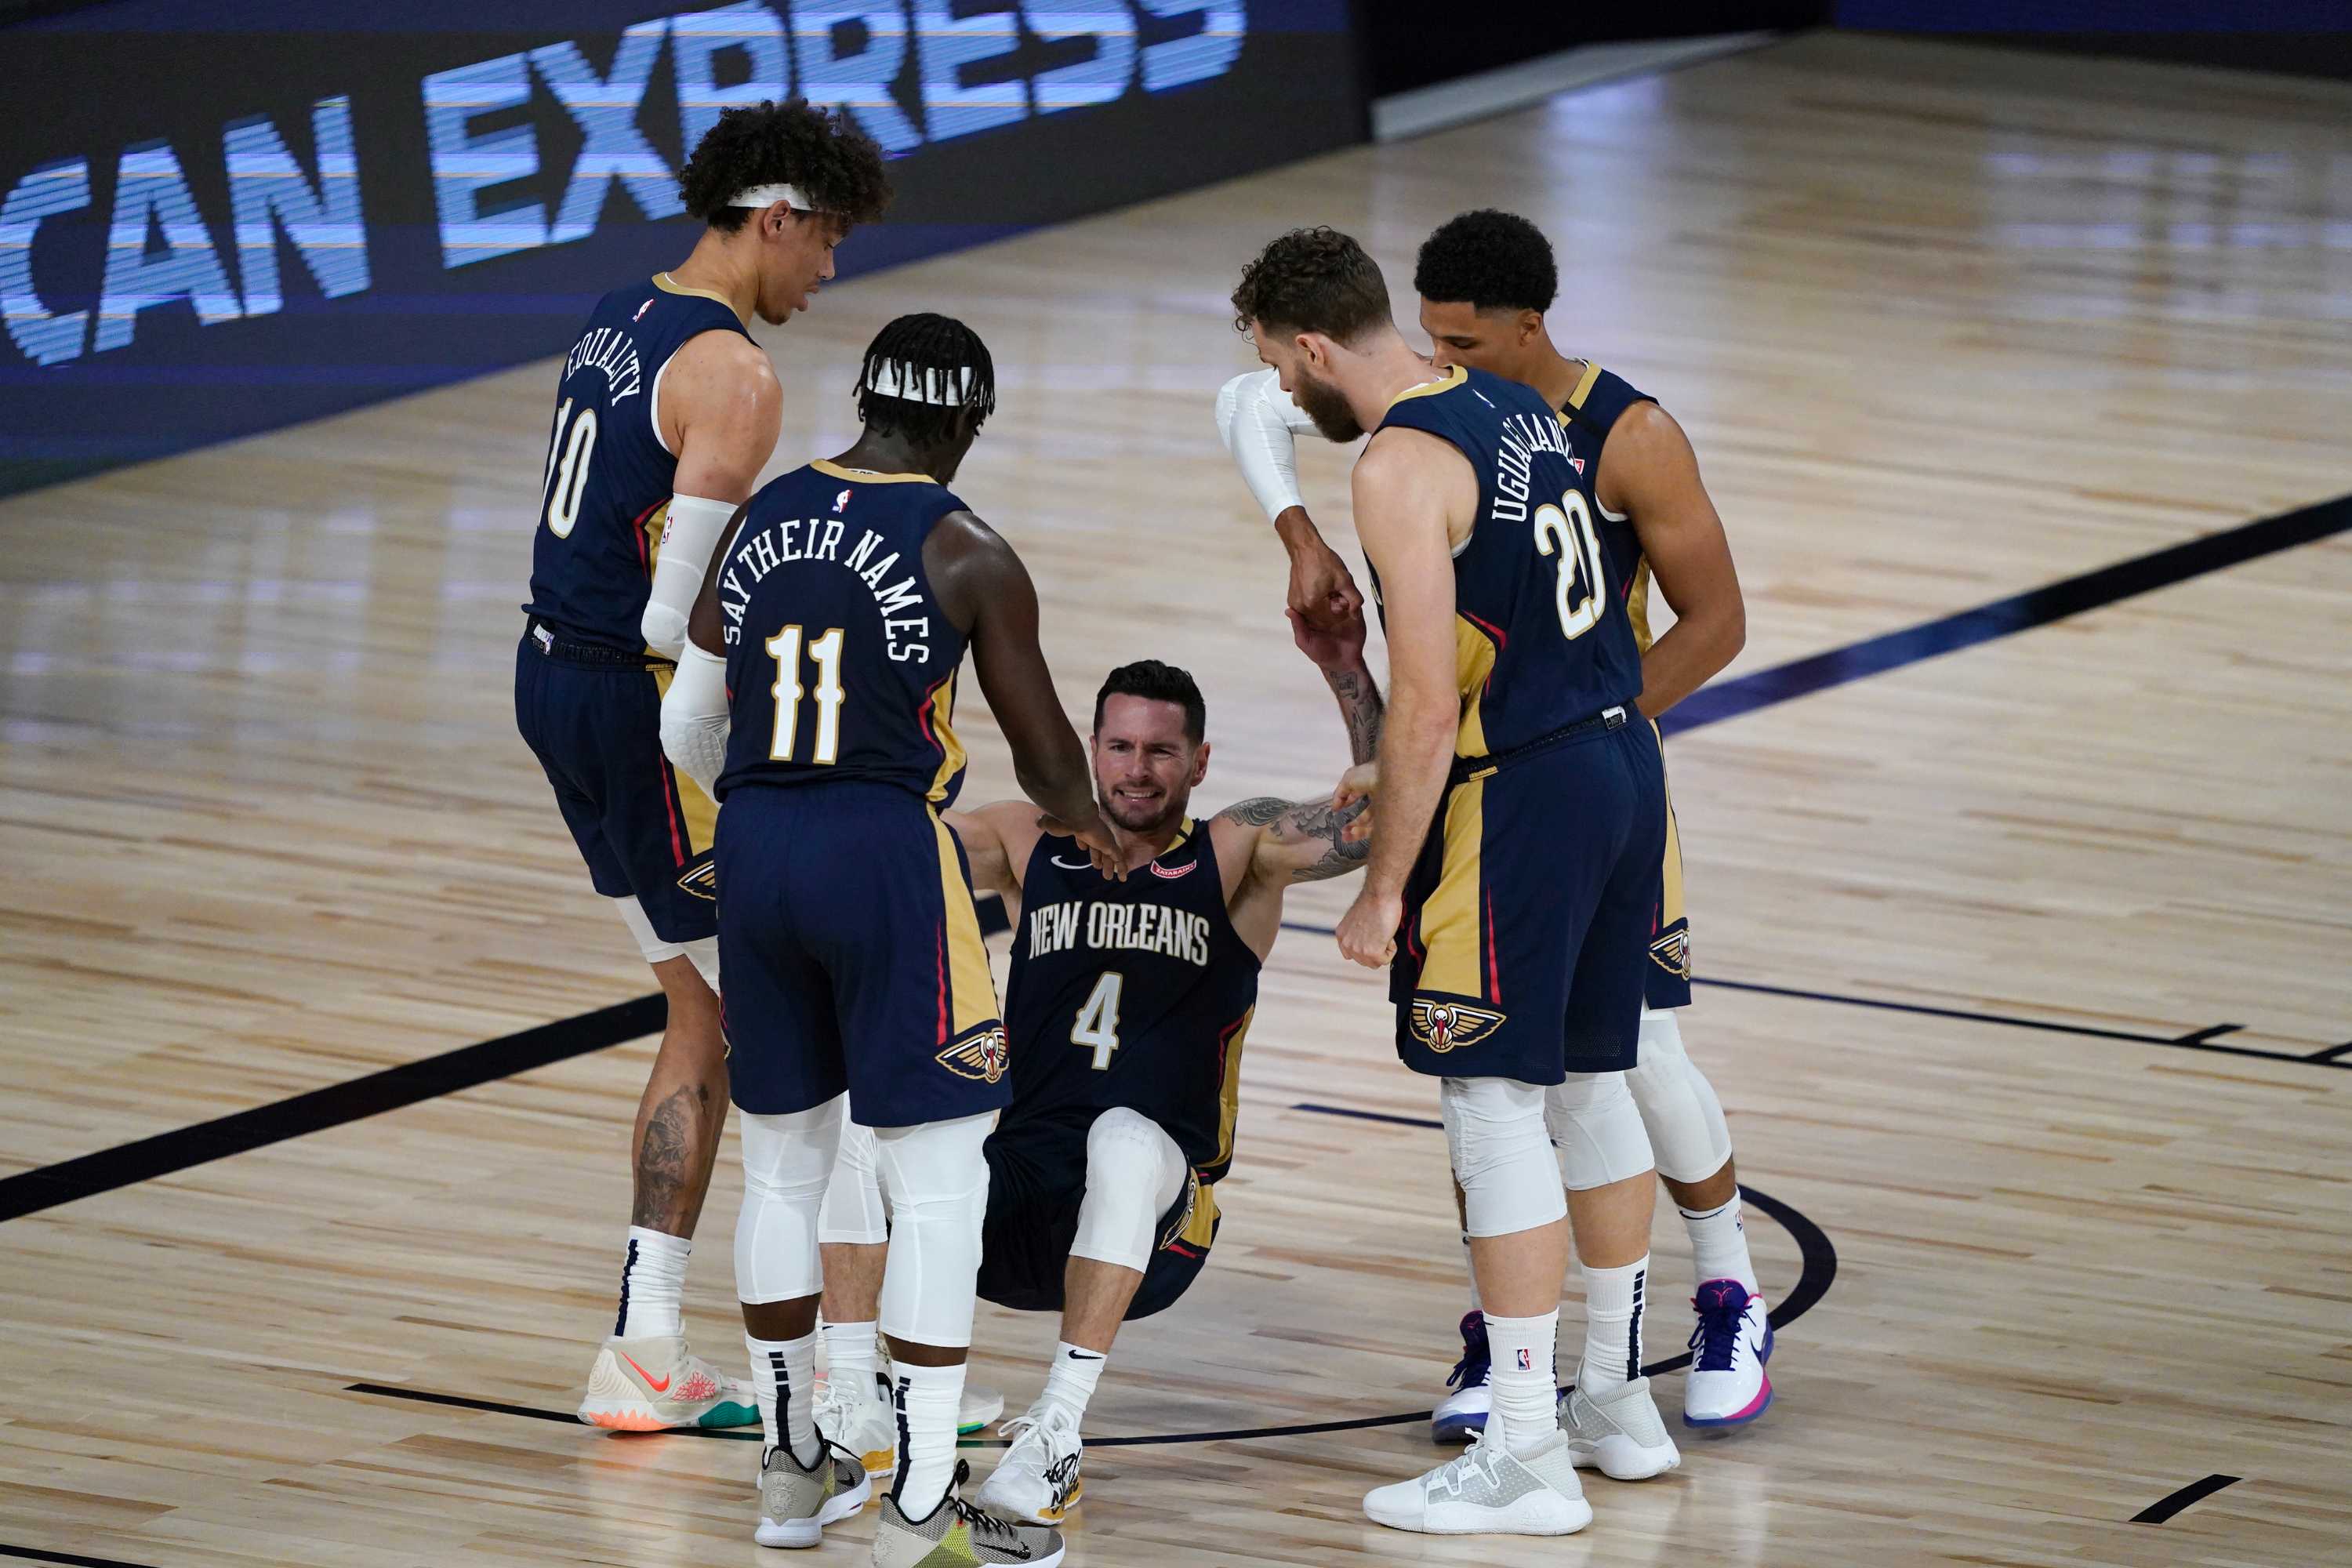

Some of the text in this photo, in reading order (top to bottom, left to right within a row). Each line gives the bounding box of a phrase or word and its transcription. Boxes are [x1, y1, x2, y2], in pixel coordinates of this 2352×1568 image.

[0, 0, 1247, 366] CAN EXPRESS
[565, 328, 641, 407] EQUALITY
[721, 518, 930, 663] SAY THEIR NAMES
[1534, 488, 1606, 641] 20
[764, 623, 846, 765] 11
[1029, 900, 1210, 967] NEW ORLEANS
[1070, 971, 1123, 1072] 4
